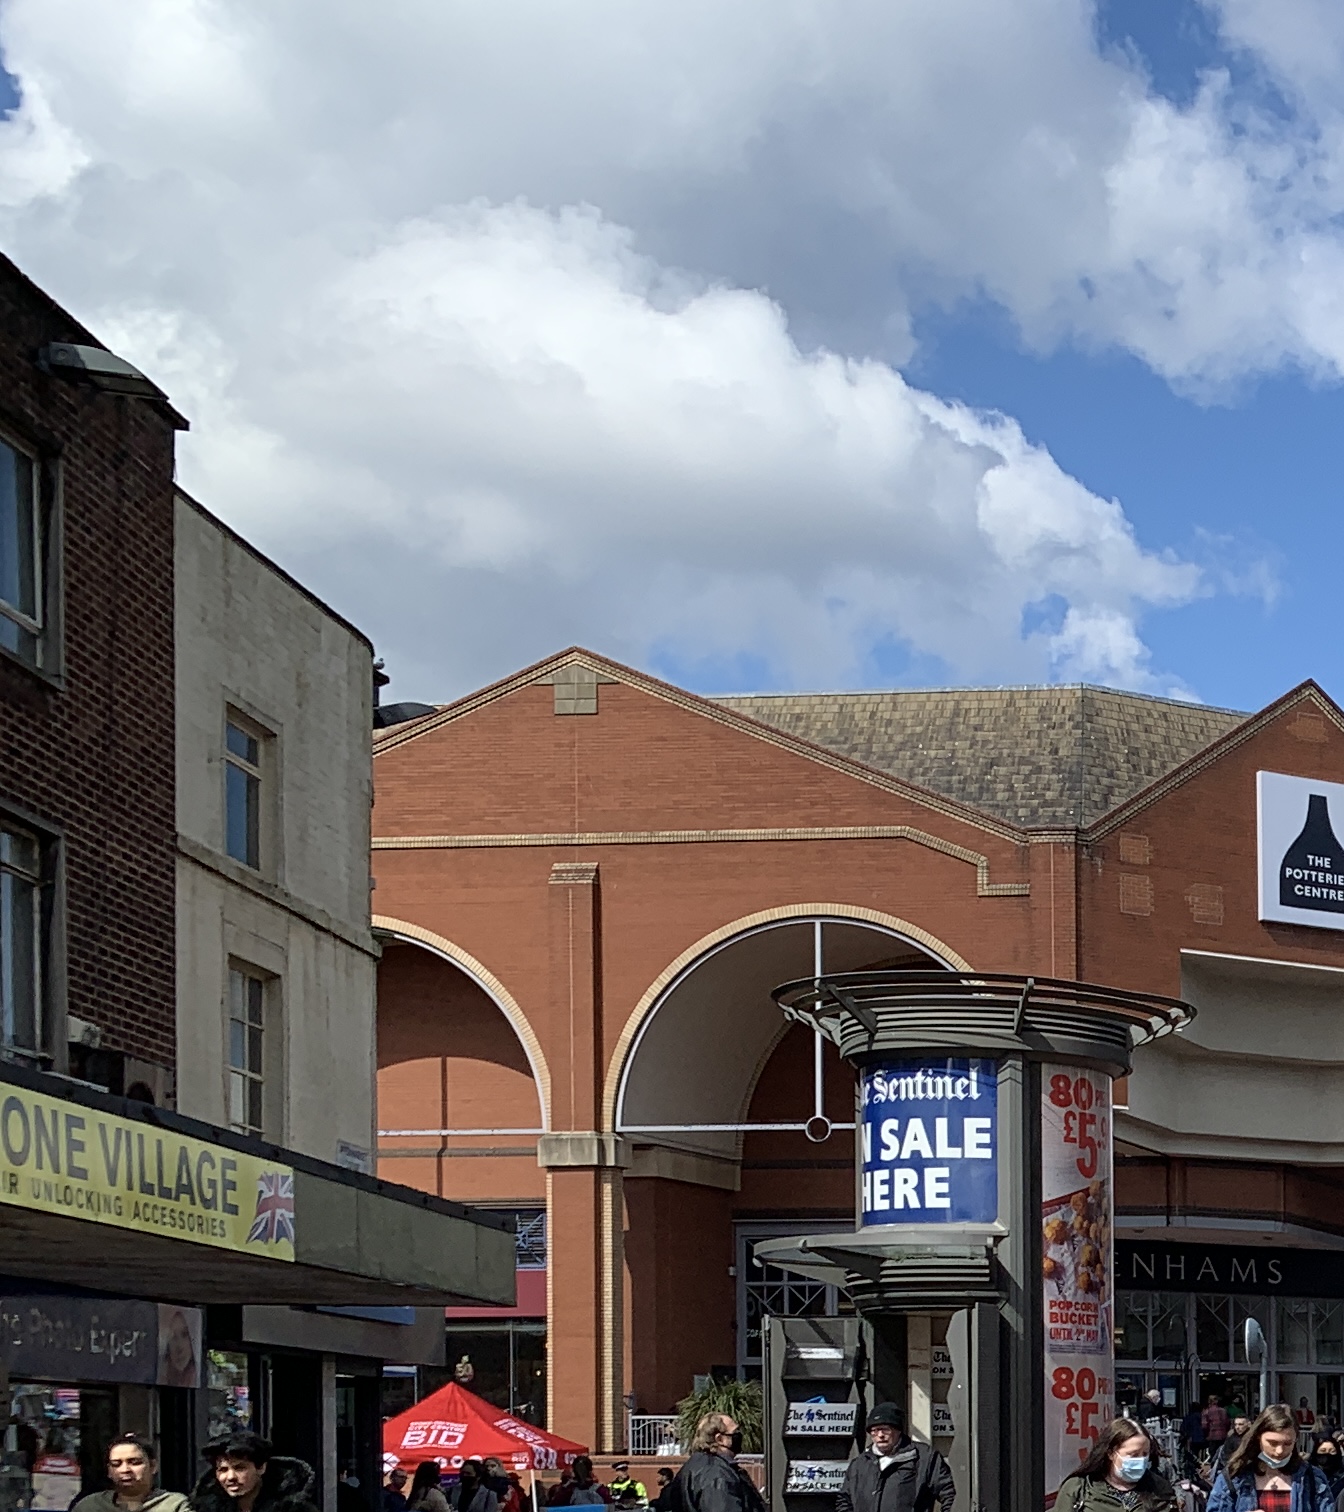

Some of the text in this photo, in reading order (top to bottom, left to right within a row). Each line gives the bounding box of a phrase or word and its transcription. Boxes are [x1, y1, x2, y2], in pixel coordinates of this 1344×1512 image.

[1307, 854, 1331, 868] THE
[1294, 884, 1344, 902] CENTRE
[873, 1068, 982, 1105] Sentinel
[1049, 1073, 1094, 1111] 80
[2, 1096, 240, 1216] ONE VILLAGE
[880, 1117, 993, 1162] SALE
[862, 1166, 951, 1214] HERE
[31, 1179, 122, 1217] UNLOCKING
[131, 1201, 226, 1239] ACCESSORIES
[1049, 1312, 1099, 1326] BUCKET
[1051, 1366, 1096, 1401] 80
[786, 1408, 854, 1422] The Sentinel
[800, 1424, 825, 1433] SALE
[828, 1424, 853, 1433] HERE
[400, 1430, 465, 1447] BID
